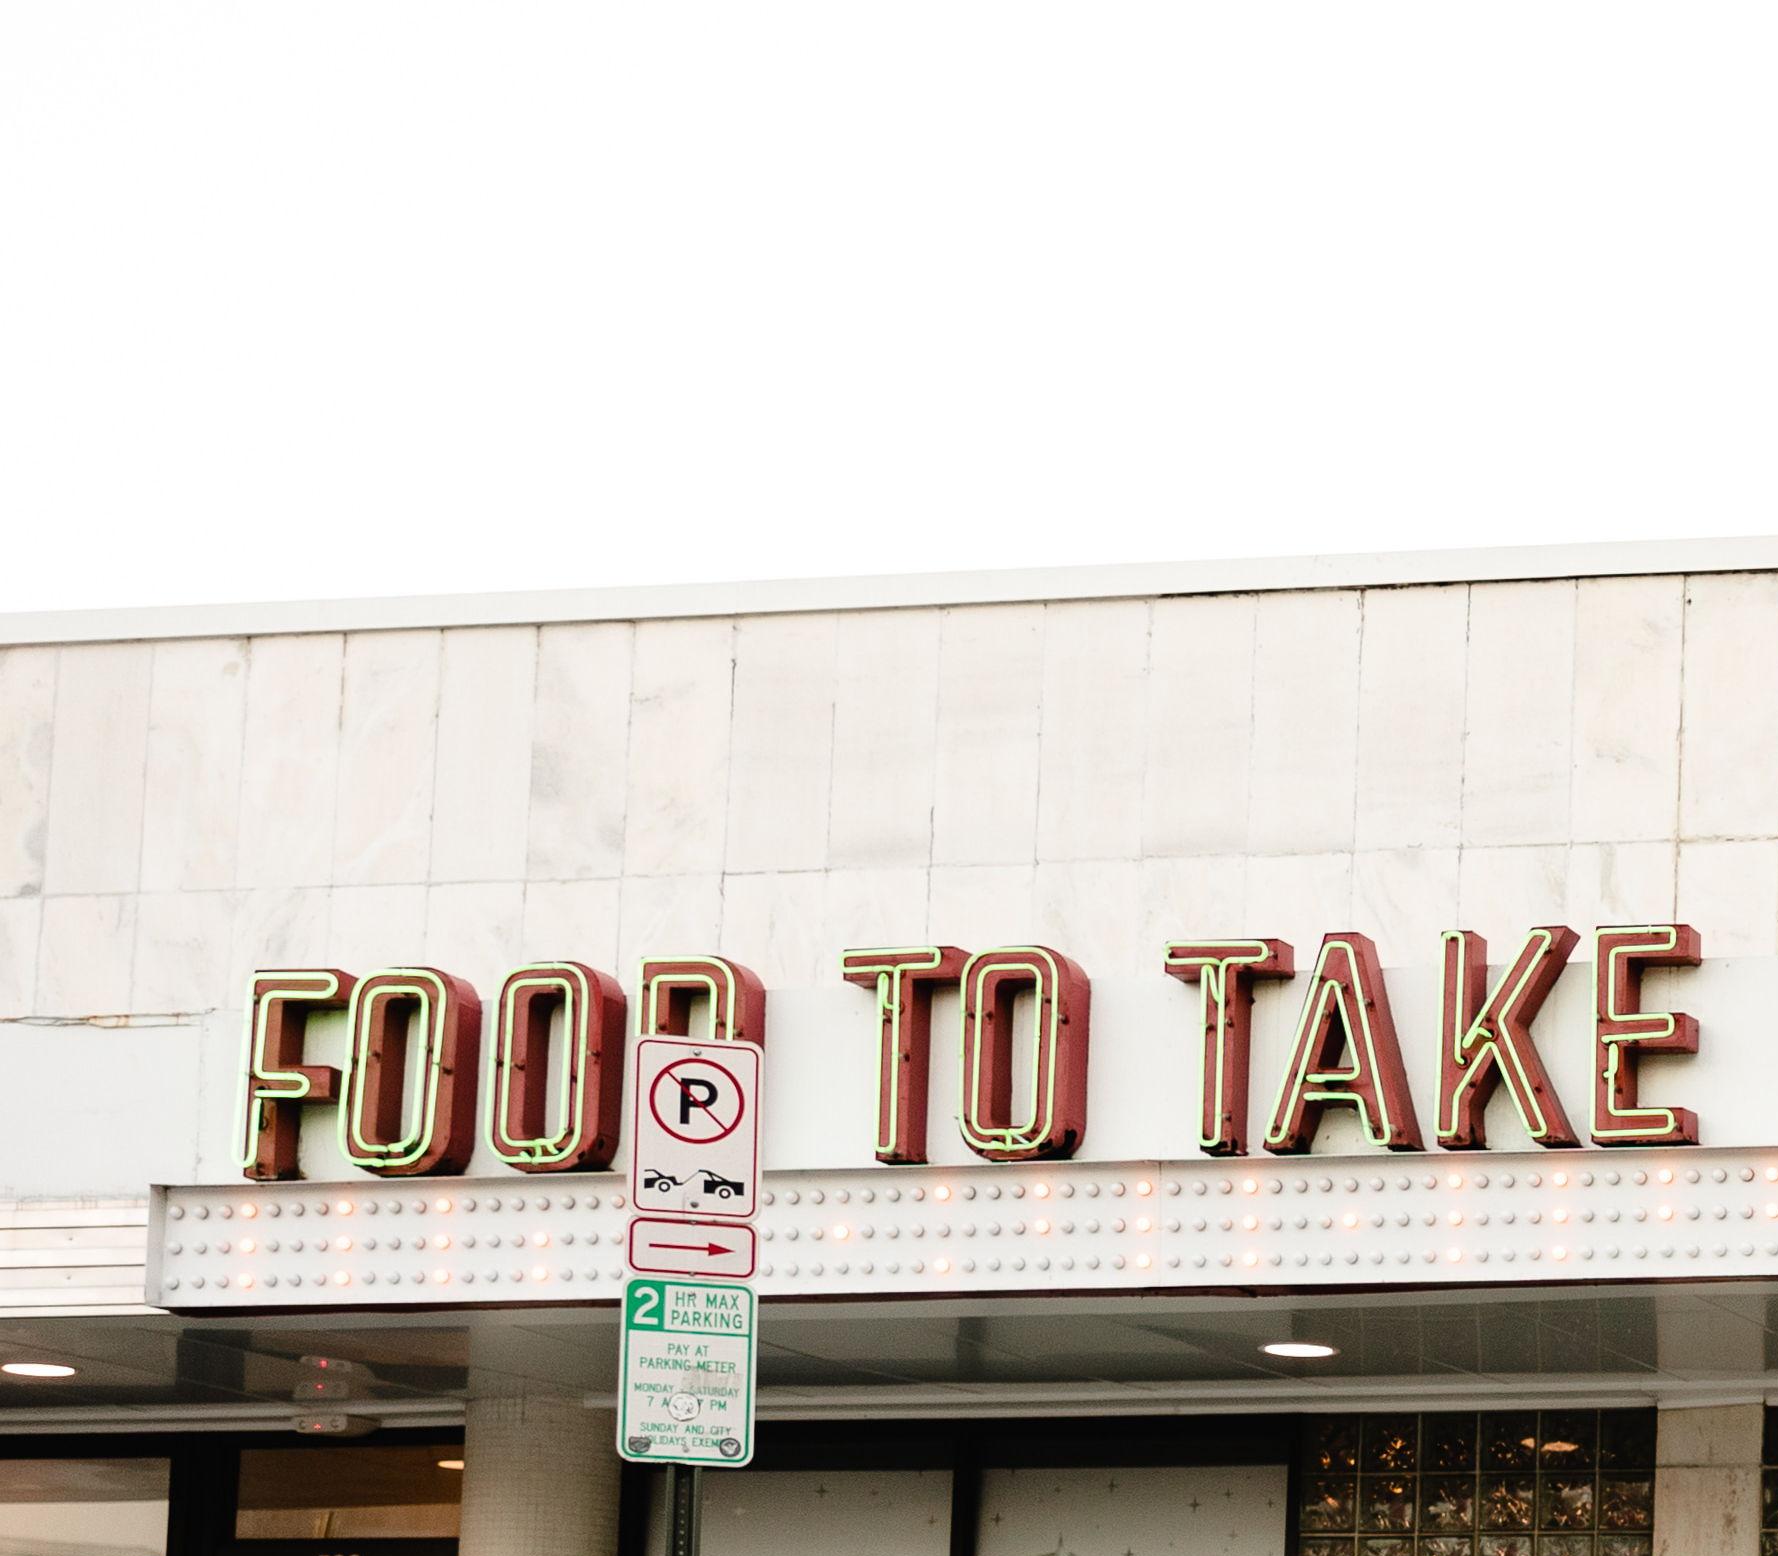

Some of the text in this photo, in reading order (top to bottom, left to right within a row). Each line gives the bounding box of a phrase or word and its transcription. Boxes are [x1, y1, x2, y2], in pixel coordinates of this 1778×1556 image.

[841, 944, 1091, 1165] TO
[1163, 924, 1702, 1156] TAKE
[633, 1286, 660, 1326] 2
[675, 1291, 740, 1311] HR MAX
[670, 1310, 744, 1329] PARKING
[667, 1343, 709, 1357] PAY AT
[639, 1357, 737, 1374] PARKING METER
[633, 1382, 740, 1398] MONDAY SATURDAY
[647, 1396, 655, 1407] 7
[710, 1400, 727, 1411] PM
[640, 1422, 679, 1434] SUNDAY
[685, 1425, 705, 1435] AND
